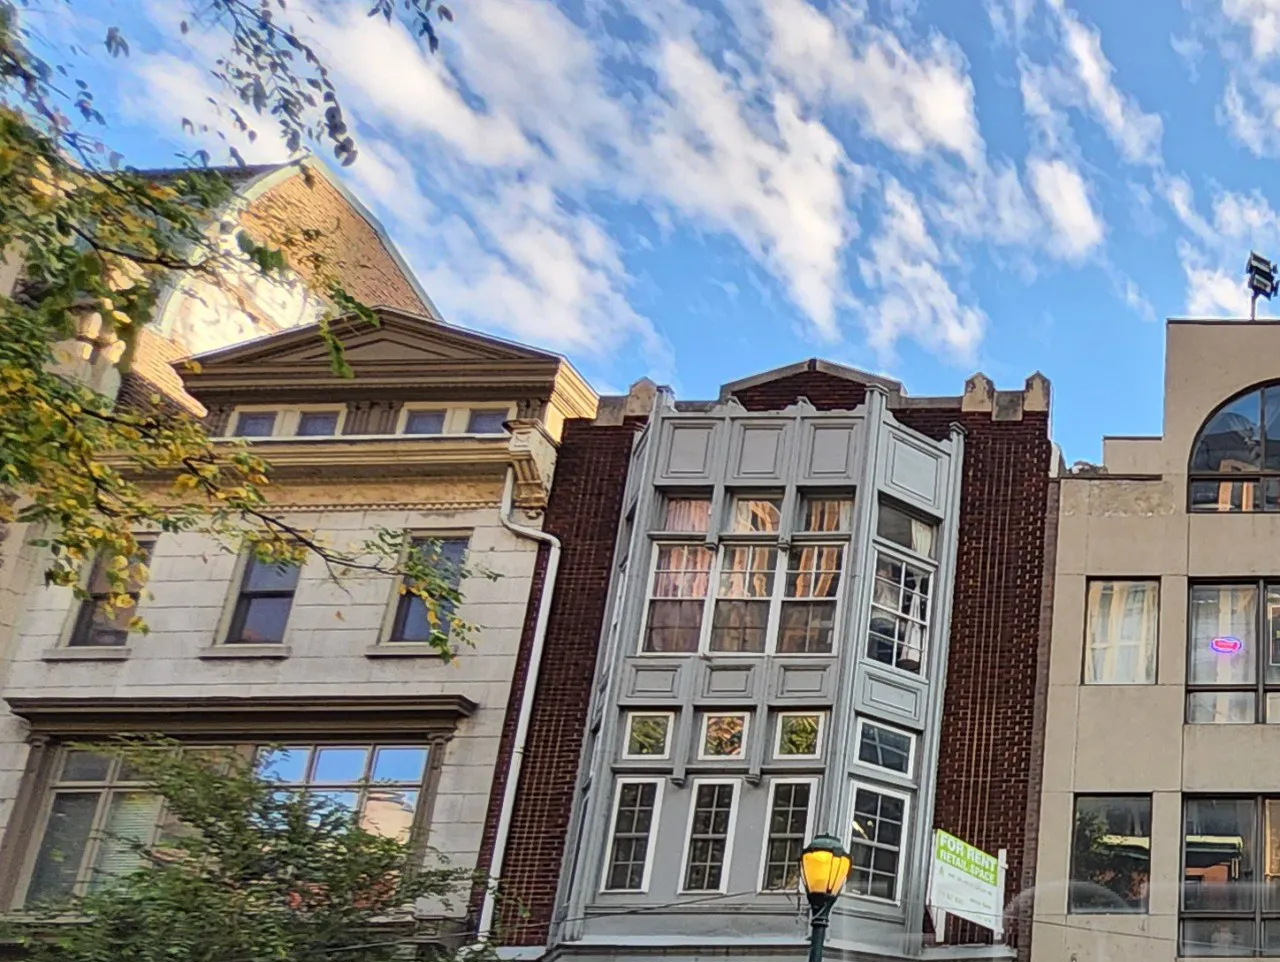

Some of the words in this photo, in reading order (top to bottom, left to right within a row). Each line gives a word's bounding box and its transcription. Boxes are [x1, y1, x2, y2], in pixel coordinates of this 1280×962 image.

[940, 834, 964, 857] FOR
[966, 846, 997, 872] RENT
[940, 849, 969, 873] RETAIL
[970, 865, 996, 885] SPACE
